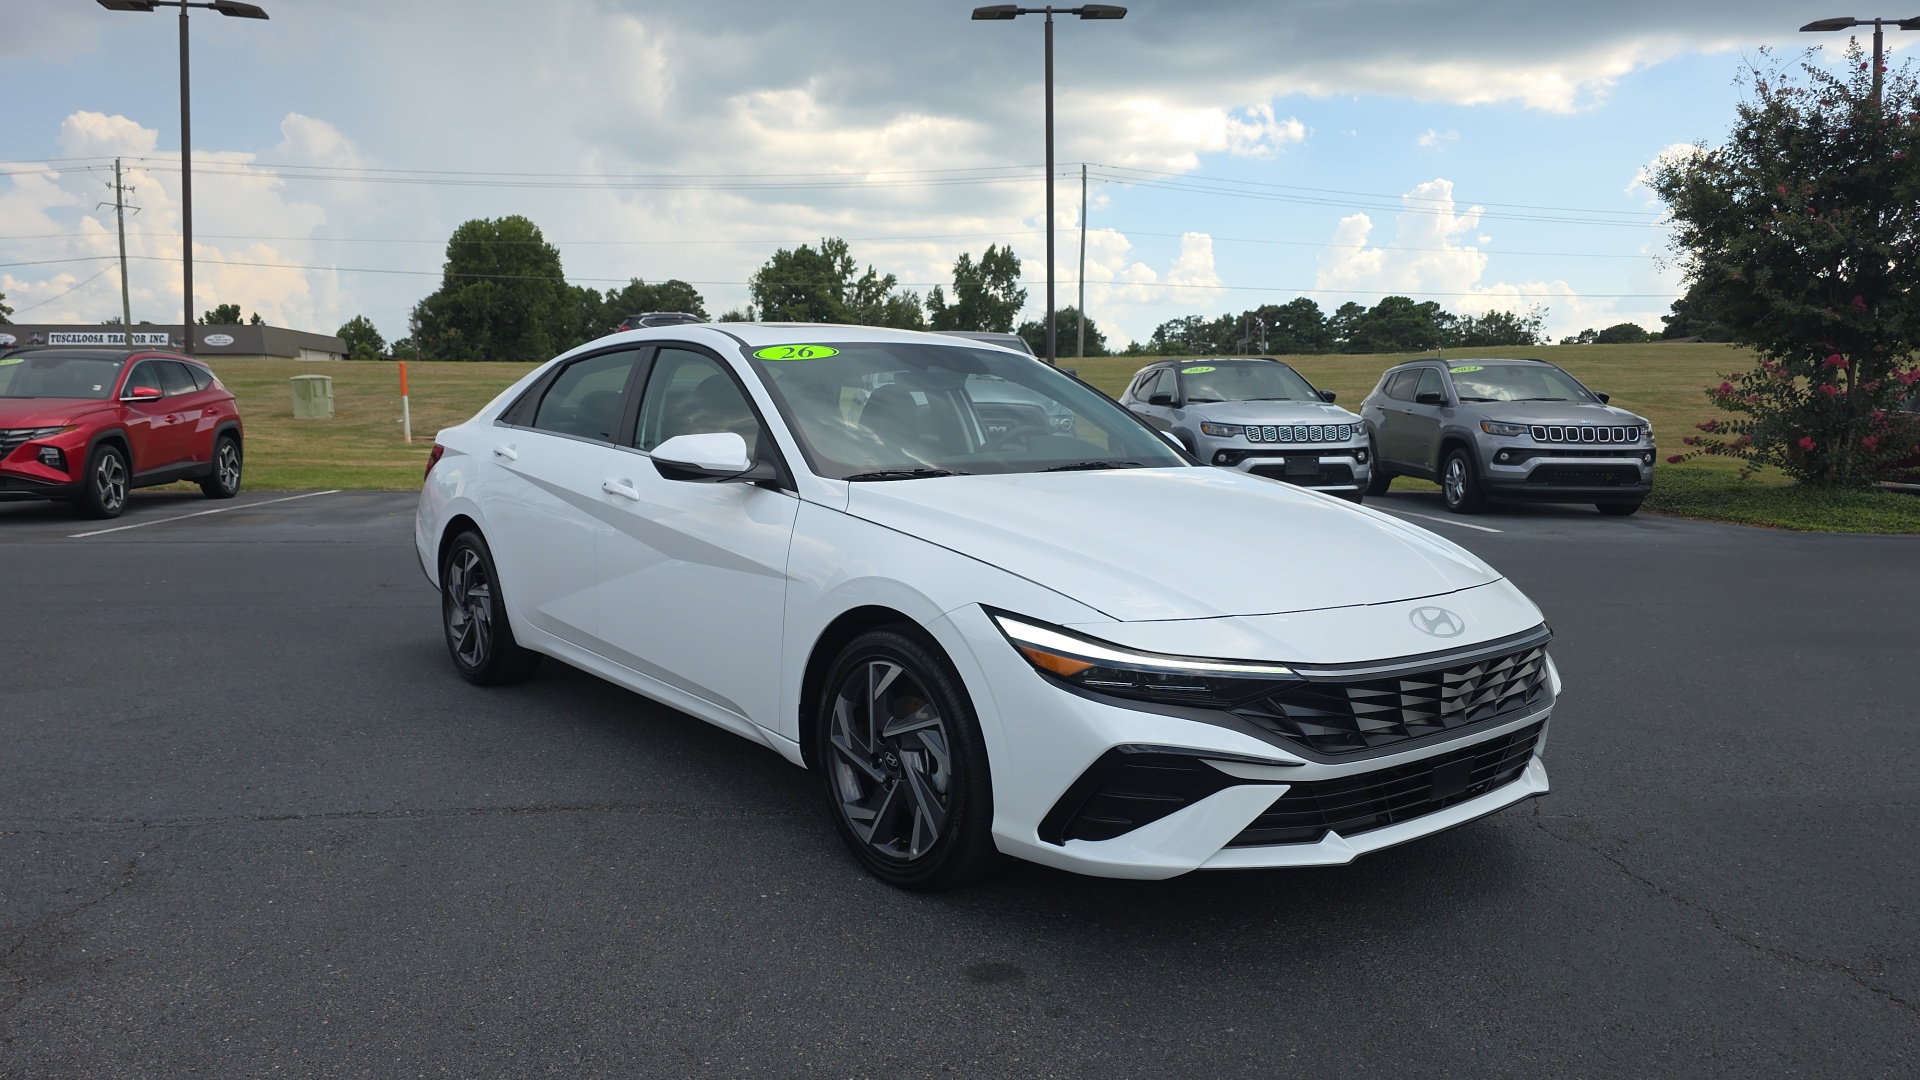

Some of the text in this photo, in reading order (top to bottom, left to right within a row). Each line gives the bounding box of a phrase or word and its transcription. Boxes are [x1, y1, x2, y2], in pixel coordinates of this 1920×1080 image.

[50, 334, 167, 343] TUSCALOOSA TRAOR INC.
[780, 346, 813, 359] 26
